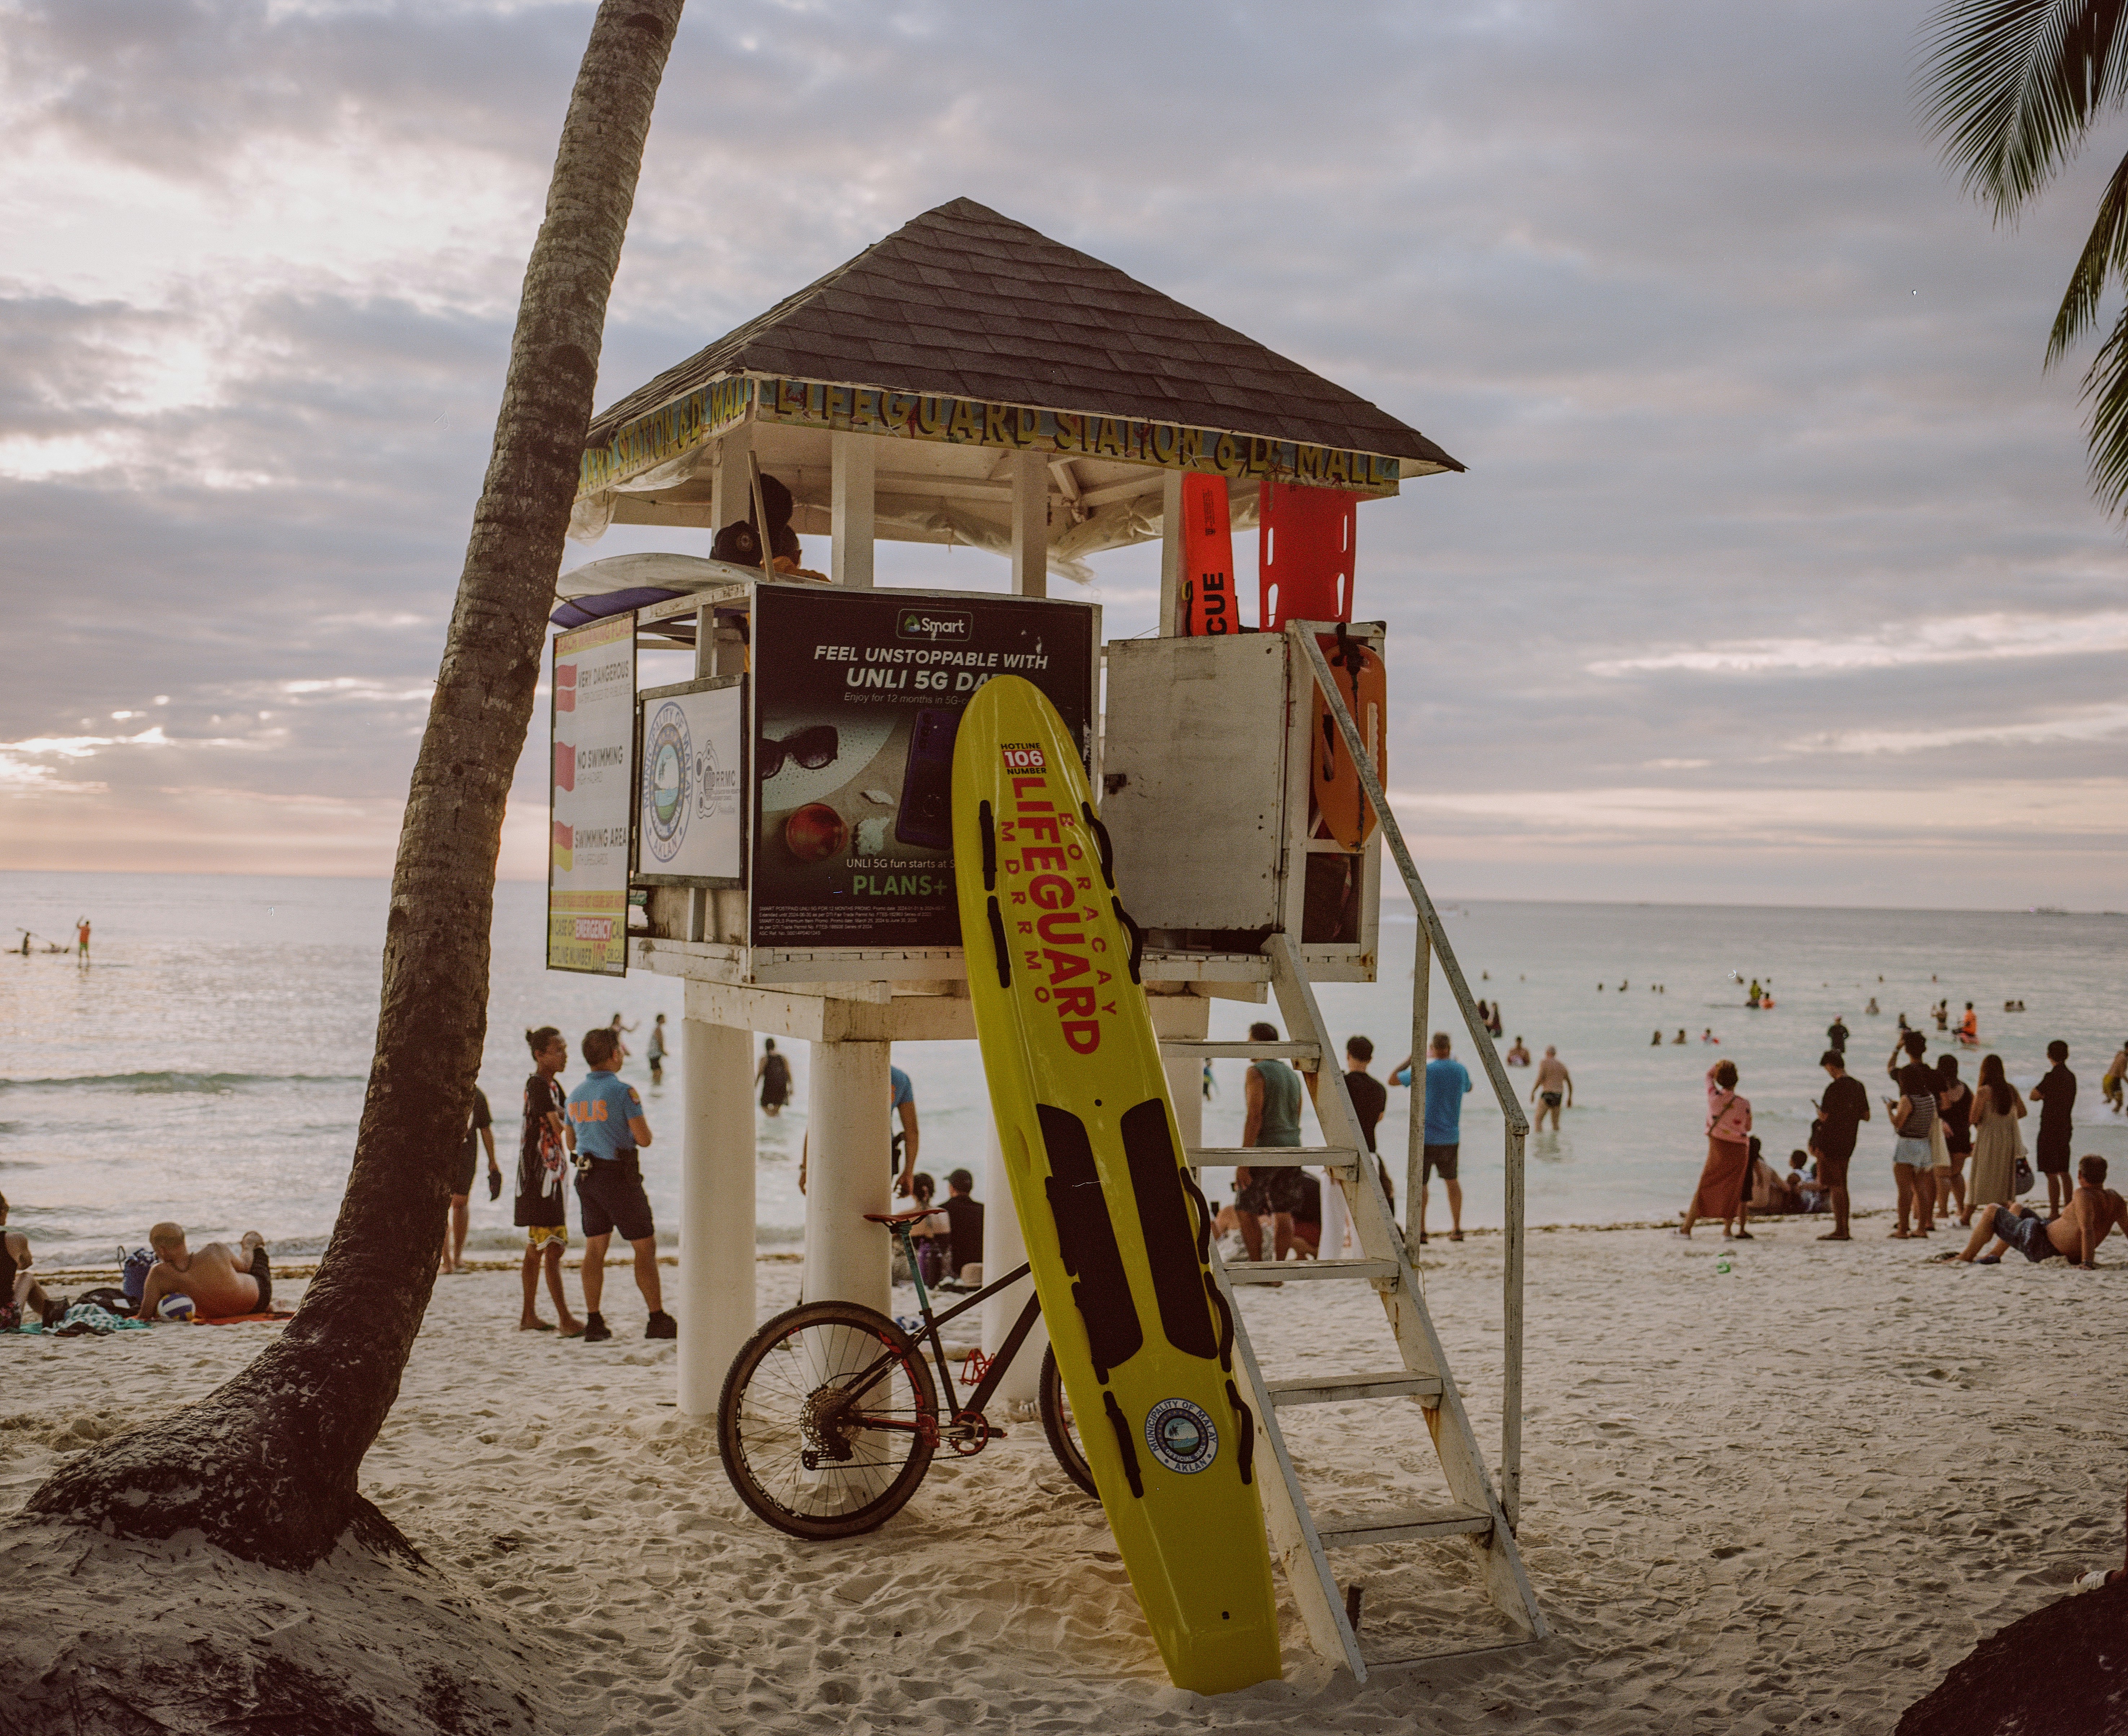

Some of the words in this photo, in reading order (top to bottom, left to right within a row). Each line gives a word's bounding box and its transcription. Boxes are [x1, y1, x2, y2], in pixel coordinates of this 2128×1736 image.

[710, 378, 747, 433] MALL
[775, 379, 1040, 446] LIFEGUARD
[1294, 443, 1385, 485] MALL
[922, 618, 964, 633] Smart
[814, 646, 858, 661] FEEL
[865, 648, 998, 667] UNSTOPPABLE
[1003, 654, 1048, 669] WITH
[578, 670, 592, 688] VERY
[594, 661, 629, 685] DANGEROUS
[847, 668, 908, 688] UNLI
[914, 670, 949, 690] 5G
[955, 672, 1005, 691] DA
[844, 692, 869, 705] Enjoy
[900, 695, 932, 704] months
[577, 750, 587, 769] NO
[588, 745, 623, 769] SWIMMING
[675, 711, 683, 729] OF
[682, 733, 691, 804] MALAY
[1005, 750, 1043, 767] 106
[575, 828, 608, 848] SWIMMING
[610, 827, 627, 847] AREA
[654, 835, 677, 858] AKLAN
[847, 859, 871, 868] UNLI
[874, 859, 887, 868] 5G
[890, 859, 906, 868] fun
[853, 875, 947, 895] PLANS+
[1001, 821, 1050, 1003] MDRRMO
[1011, 777, 1100, 1055] LIFEGUARD
[1059, 813, 1117, 1015] BORACAY
[576, 919, 610, 939] EMERGENCY
[1146, 1400, 1178, 1452] MUNICIPALITY
[1182, 1401, 1195, 1410] OF
[1196, 1409, 1217, 1443] MALAY
[1174, 1459, 1207, 1471] AKLAN
